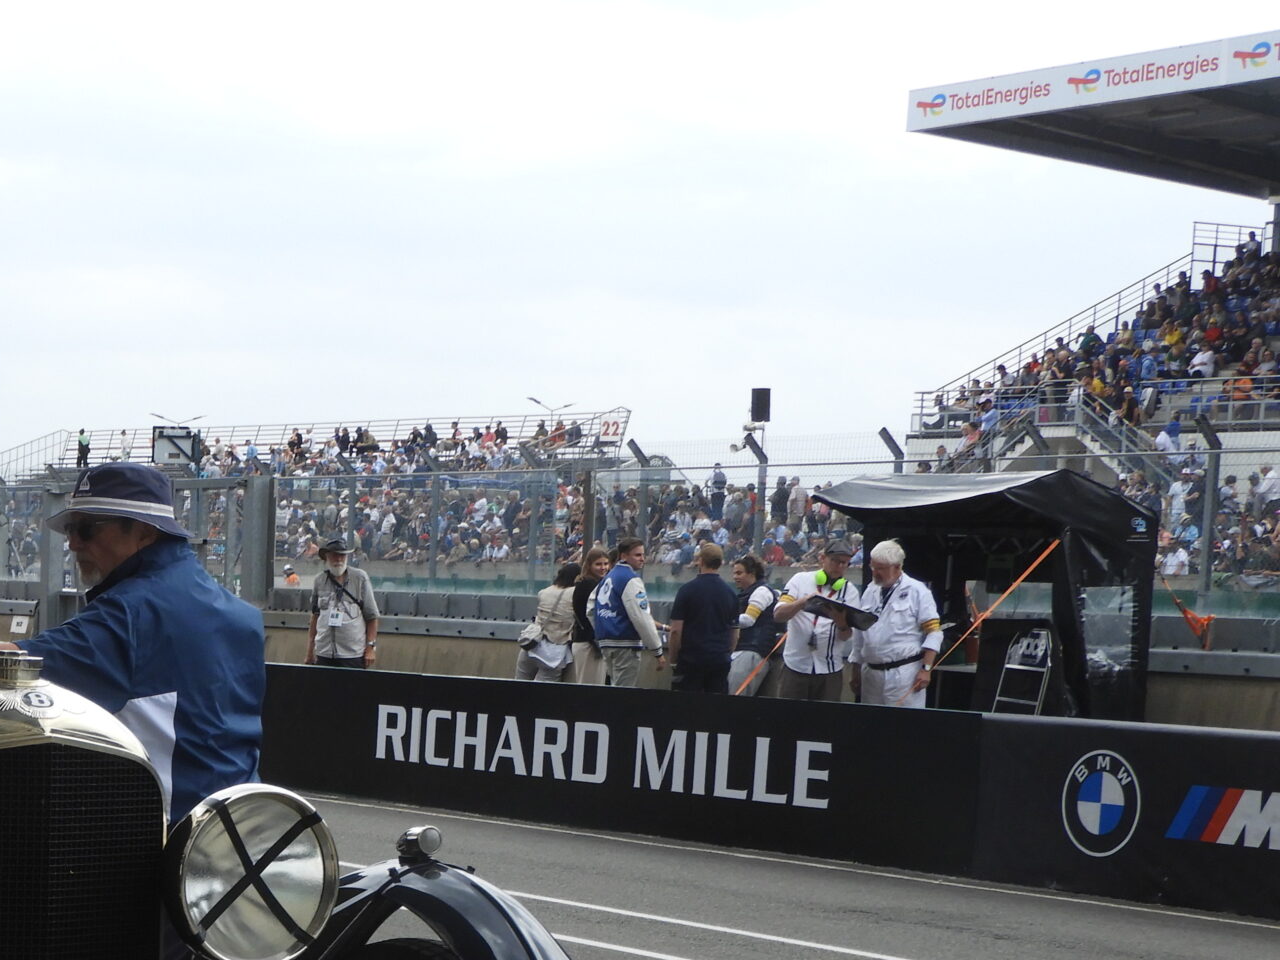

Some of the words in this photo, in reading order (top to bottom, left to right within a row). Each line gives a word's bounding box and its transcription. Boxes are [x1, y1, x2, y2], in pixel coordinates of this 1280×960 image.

[1104, 55, 1219, 88] TotalEnergies
[948, 81, 1051, 112] TotalEnergies
[601, 421, 620, 436] 22
[375, 704, 610, 784] RICHARD
[633, 726, 832, 809] MILLE
[1074, 756, 1132, 786] BMW
[1216, 789, 1280, 850] M
